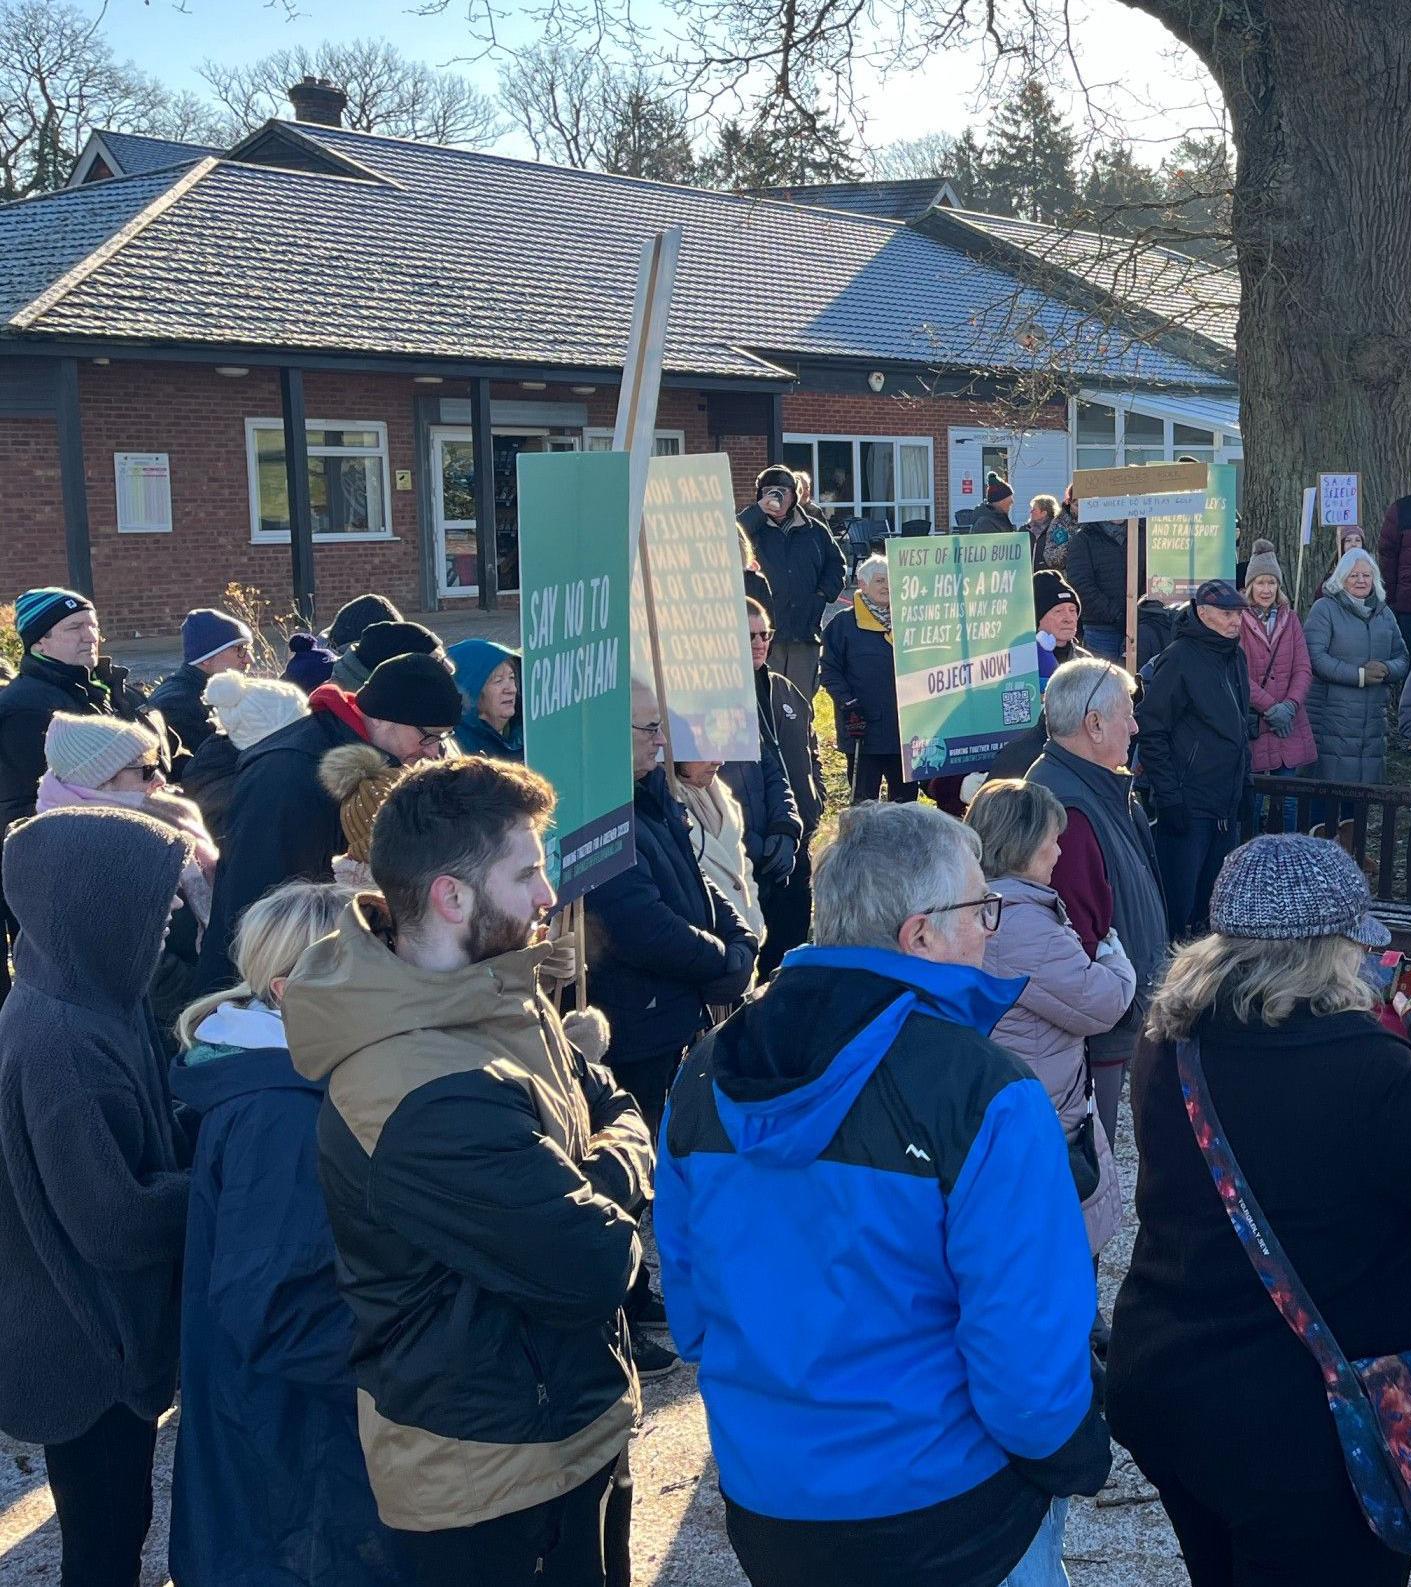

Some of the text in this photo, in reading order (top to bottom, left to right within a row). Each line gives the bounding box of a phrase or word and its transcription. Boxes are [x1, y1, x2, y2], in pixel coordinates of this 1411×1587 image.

[1323, 477, 1351, 487] SAVE
[1324, 487, 1357, 499] IFIELD
[1204, 496, 1227, 510] LEY'S
[1325, 509, 1352, 523] CLUB
[1151, 523, 1220, 537] AND TRANSPORT
[899, 543, 1022, 567] WEST OF IFIELD BUILD
[900, 569, 1017, 601] 30+ HGVs A DAY
[528, 583, 559, 651] SAY
[563, 579, 585, 640] NO
[590, 574, 610, 632] TO
[901, 598, 1008, 623] PASSING THIS WAY FOR
[902, 620, 1002, 647] AT LEAST 2 YEARS?
[530, 637, 619, 721] CRAWSHAM
[927, 652, 1012, 695] OBJECT NOW!
